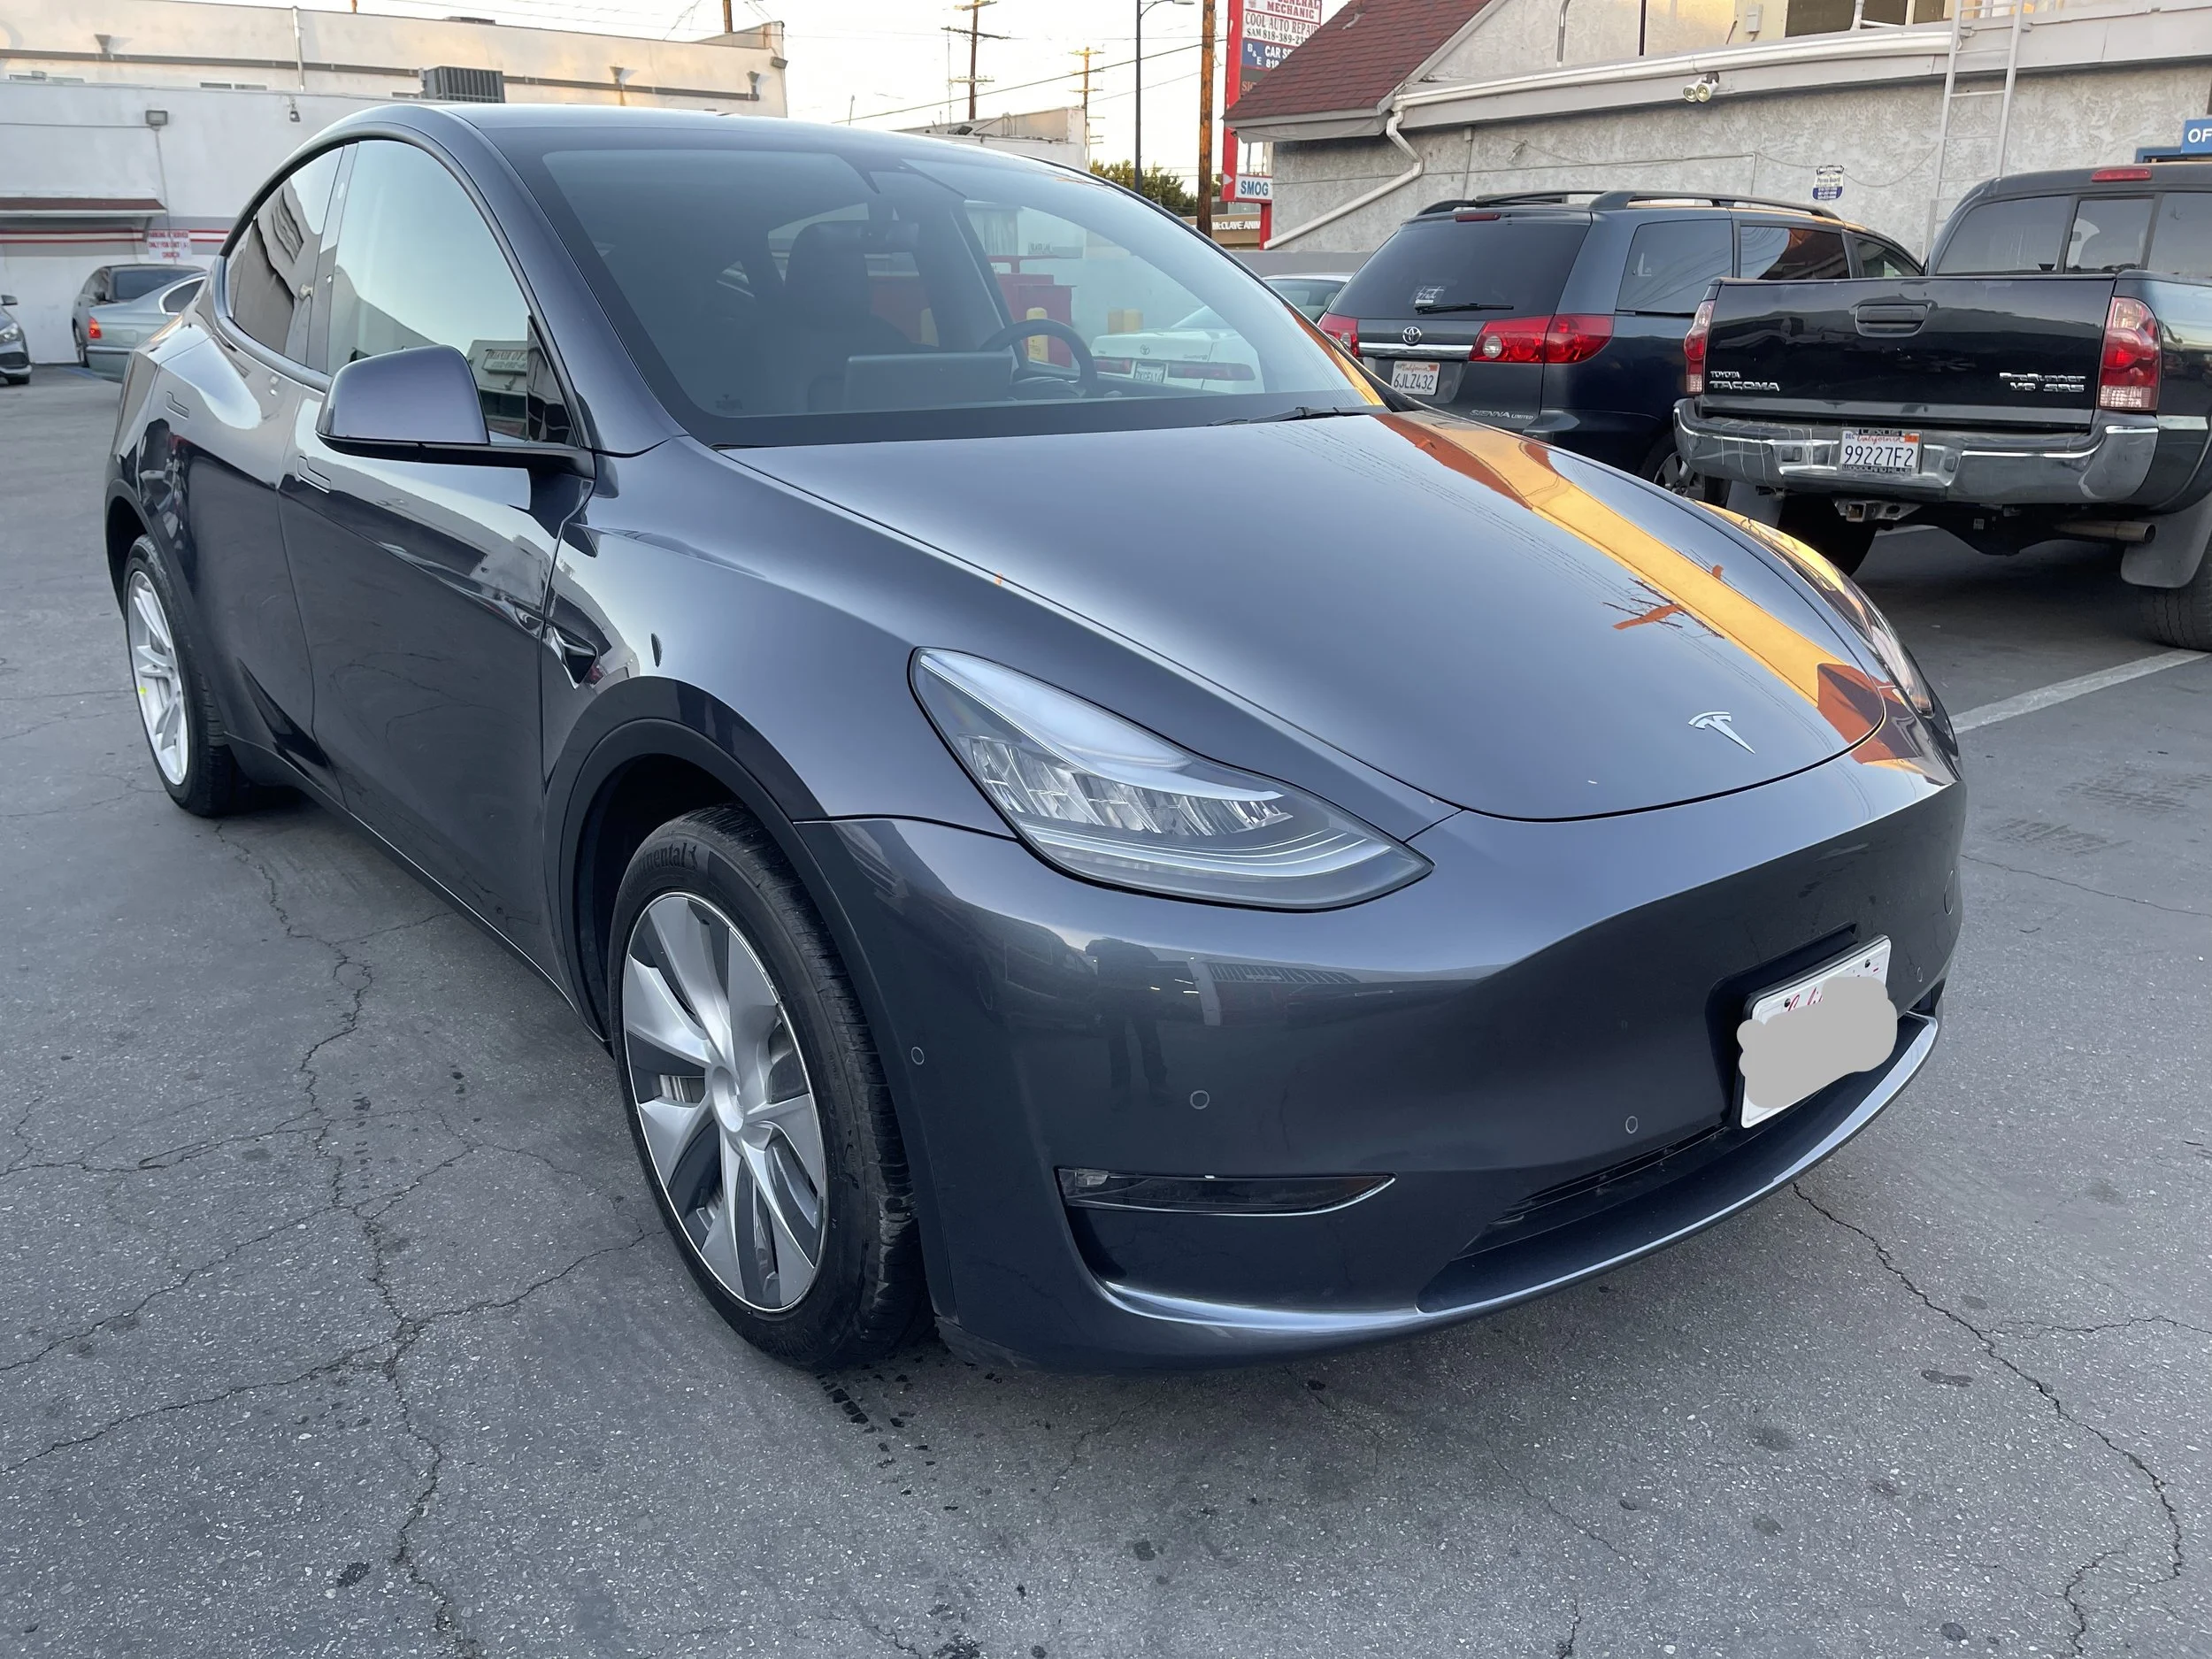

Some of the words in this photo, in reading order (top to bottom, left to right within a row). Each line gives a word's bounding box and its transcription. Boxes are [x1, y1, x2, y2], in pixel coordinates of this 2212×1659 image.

[1267, 1, 1315, 19] MECHANIC
[1246, 12, 1265, 27] COOL
[1269, 18, 1289, 32] AUTO
[1247, 27, 1261, 37] SAM
[1264, 45, 1280, 58] CAR
[1240, 180, 1269, 196] SMOG
[1394, 373, 1434, 390] 6JLZ432
[1710, 370, 1740, 379] TOYOTA
[1709, 380, 1780, 392] TACOMA
[1470, 409, 1510, 419] SIENNA
[1844, 445, 1914, 468] 99227F2
